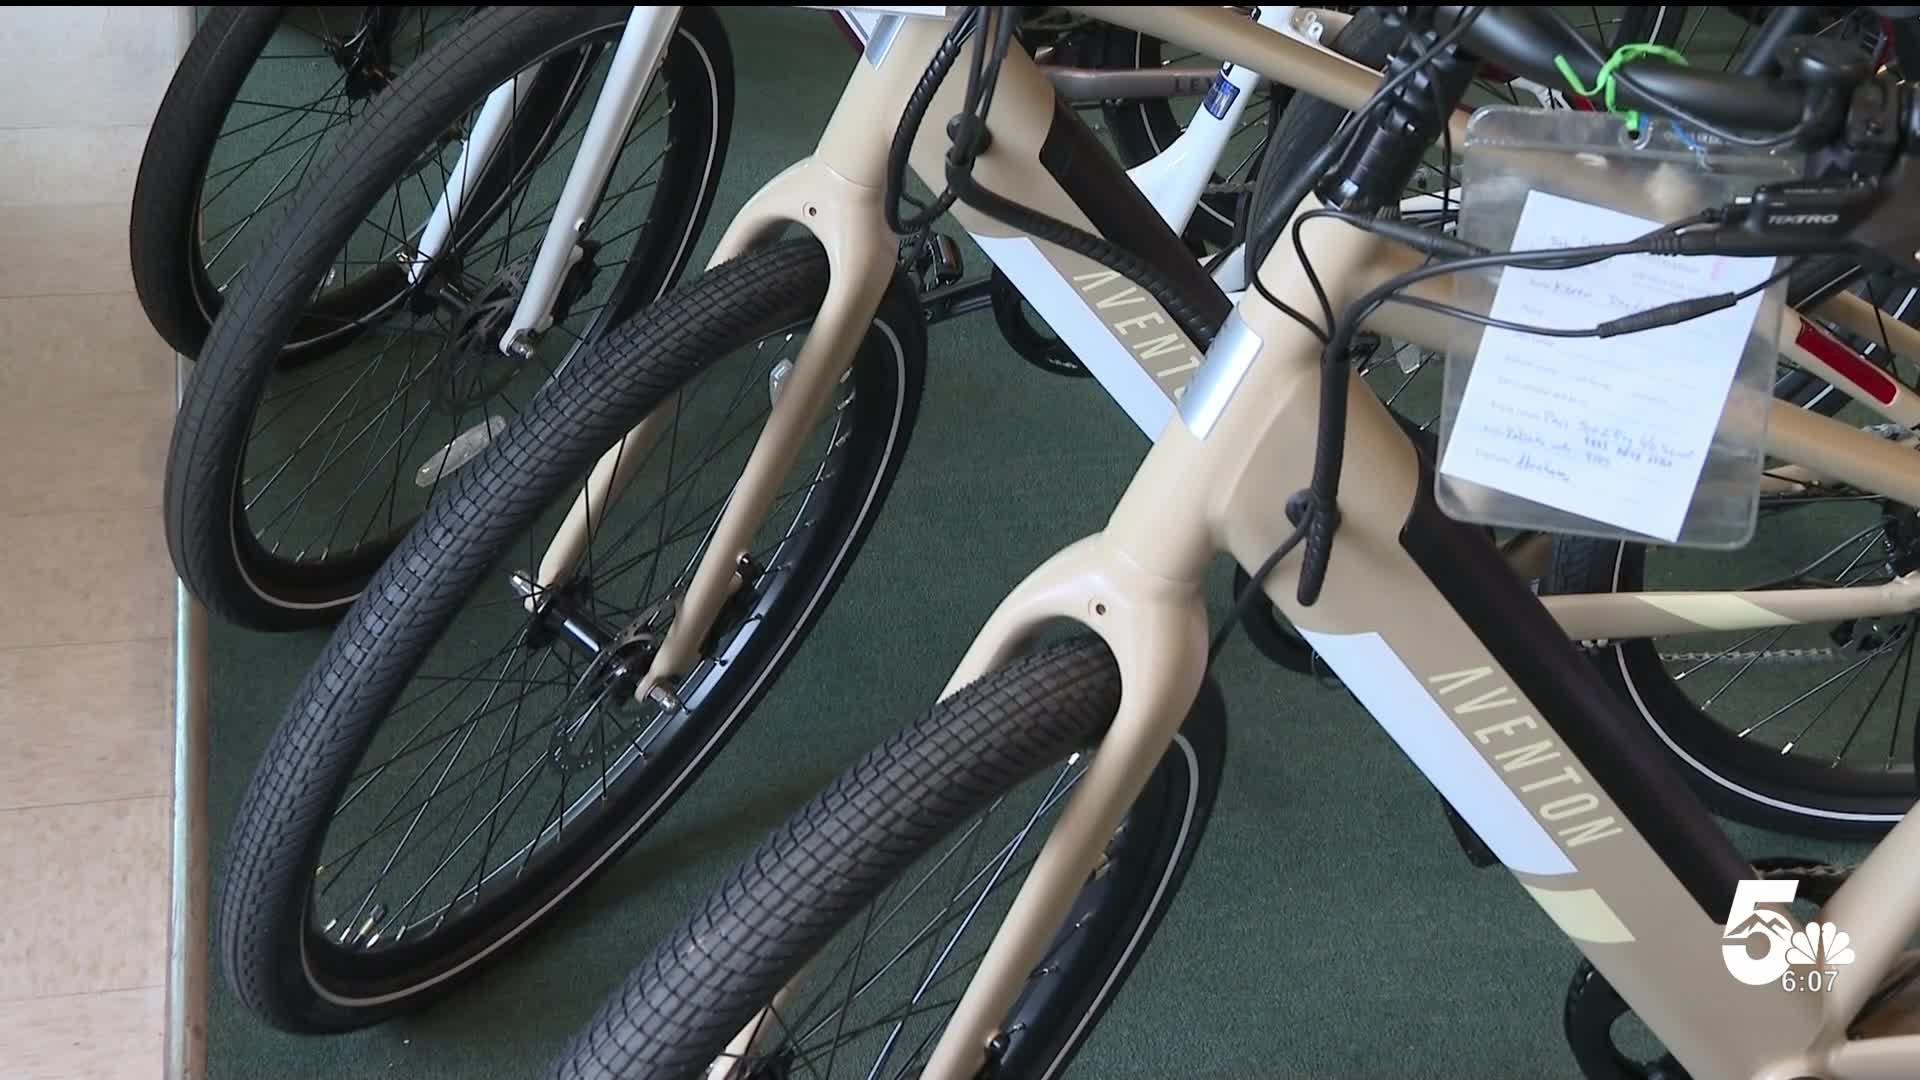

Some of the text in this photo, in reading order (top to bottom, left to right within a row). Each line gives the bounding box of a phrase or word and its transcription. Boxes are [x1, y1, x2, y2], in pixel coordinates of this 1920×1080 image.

[1768, 213, 1840, 225] TEKTRO
[1073, 270, 1200, 401] AVENT
[1428, 665, 1623, 848] AVENTON
